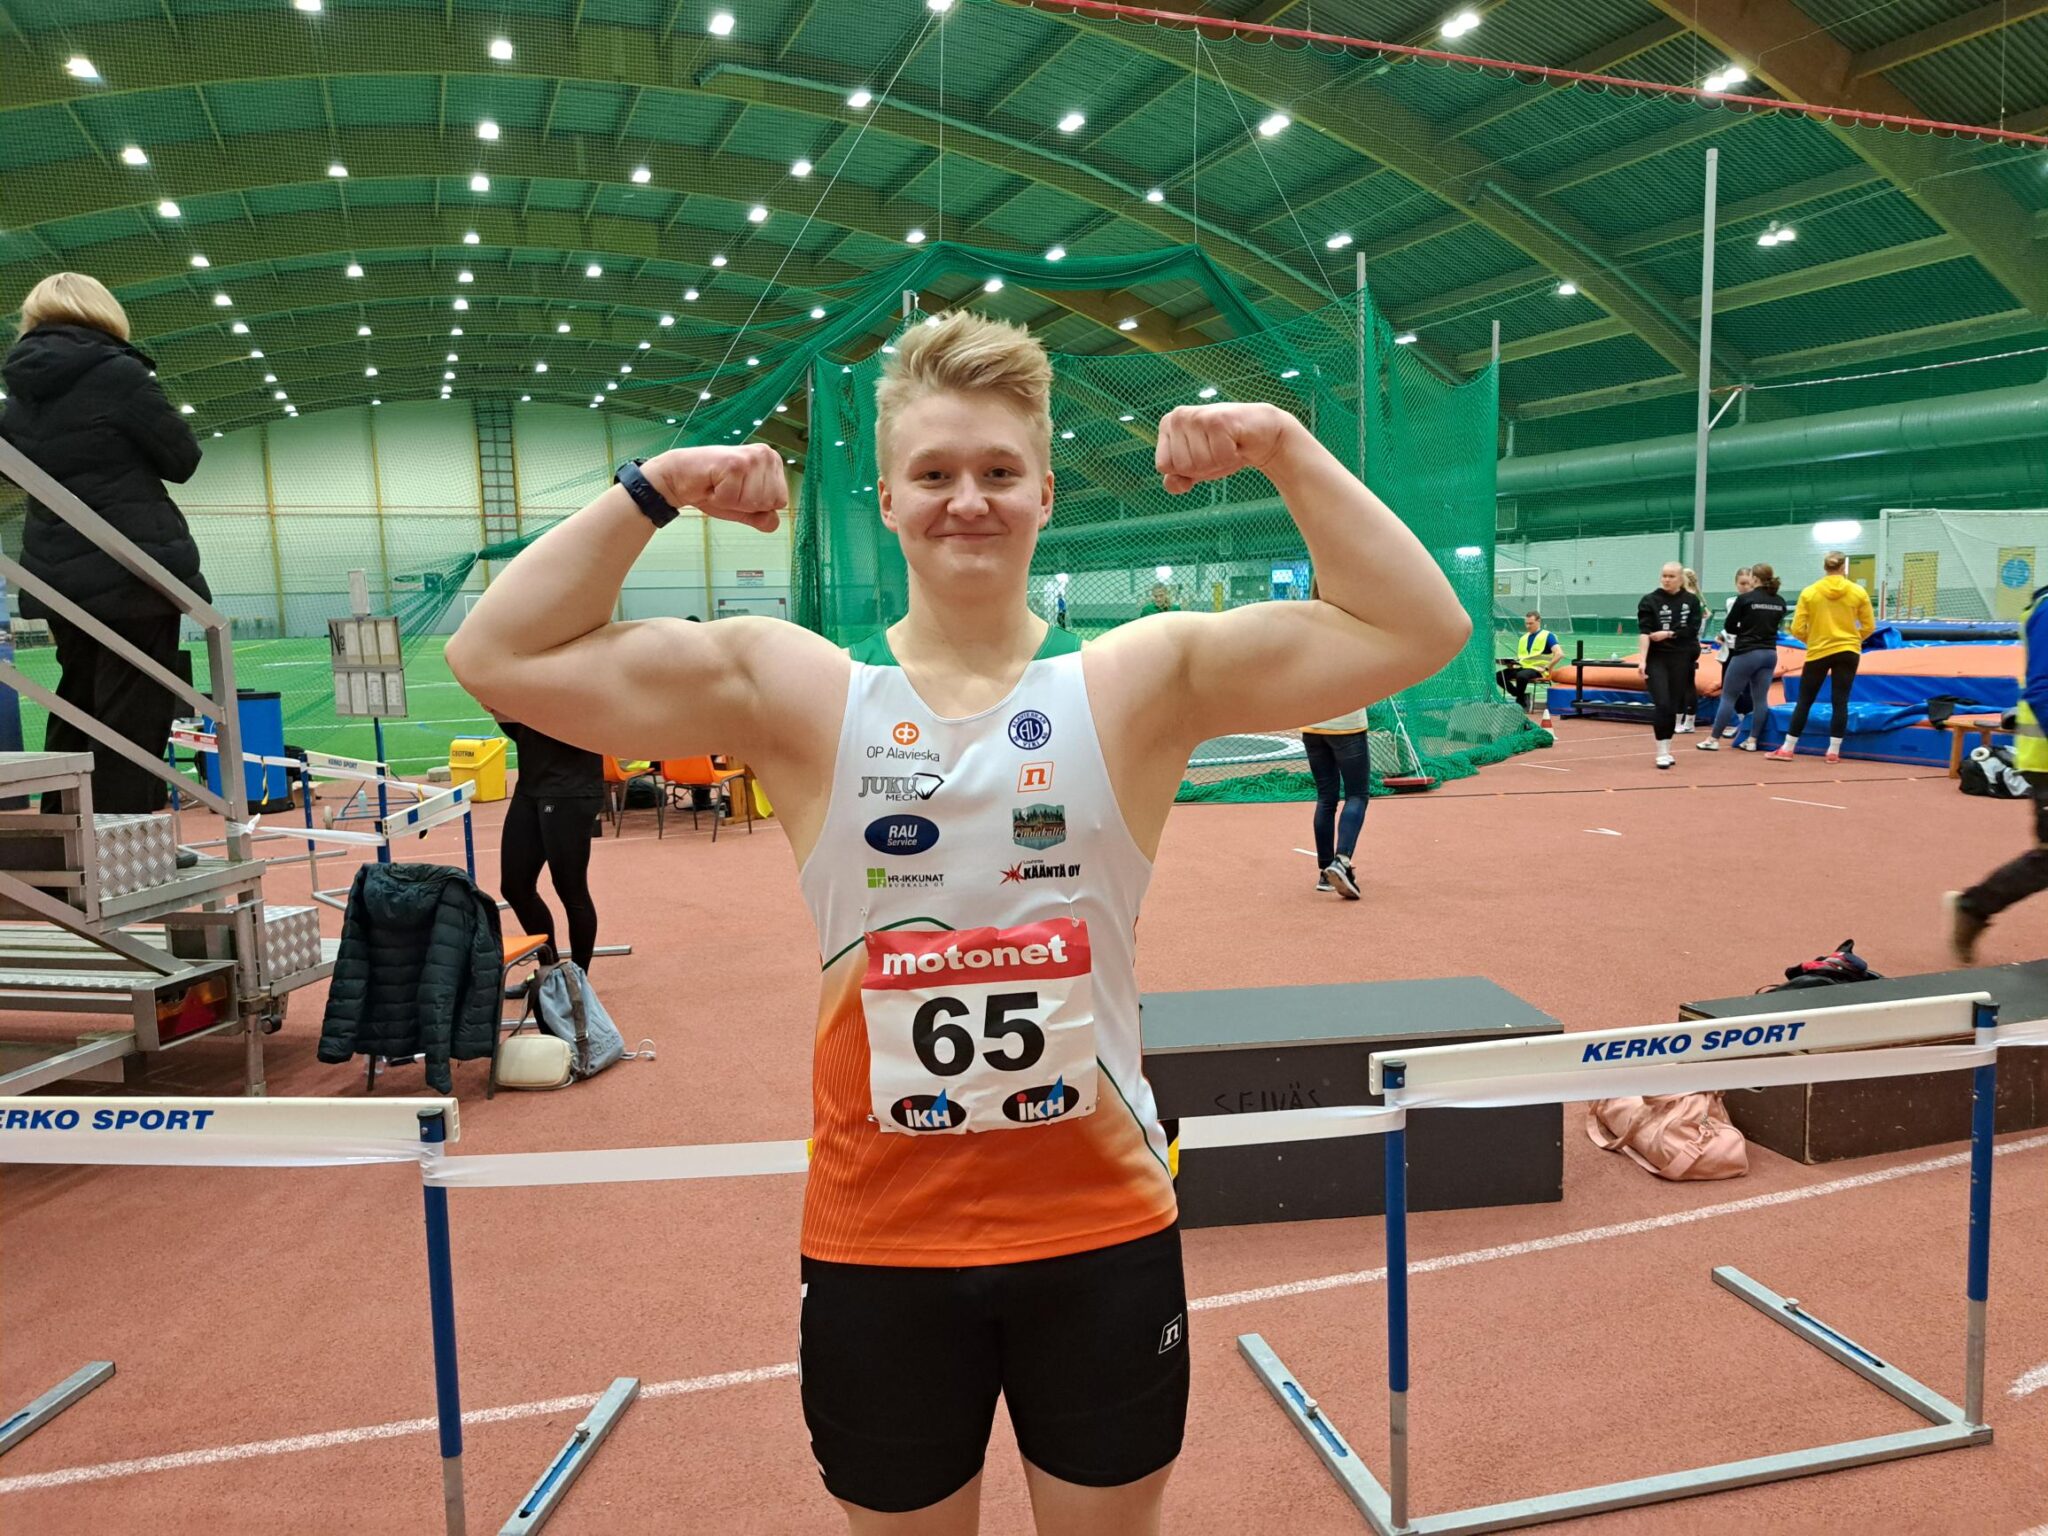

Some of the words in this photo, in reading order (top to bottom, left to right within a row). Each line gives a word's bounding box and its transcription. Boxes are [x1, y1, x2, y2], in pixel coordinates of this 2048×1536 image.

[866, 745, 884, 759] OP
[886, 746, 940, 762] Alavieska
[858, 776, 919, 798] JUKU
[888, 824, 918, 838] RAU
[887, 838, 918, 846] Service
[888, 873, 944, 883] HR-IKKUNAT
[1023, 864, 1066, 879] KÄÄNTÄ
[1068, 864, 1081, 877] OY
[882, 934, 1068, 975] motonet
[912, 992, 1045, 1077] 65
[1582, 1033, 1692, 1063] KERKO
[1701, 1022, 1805, 1051] SPORT
[0, 1109, 80, 1130] RKO
[92, 1110, 214, 1130] SPORT
